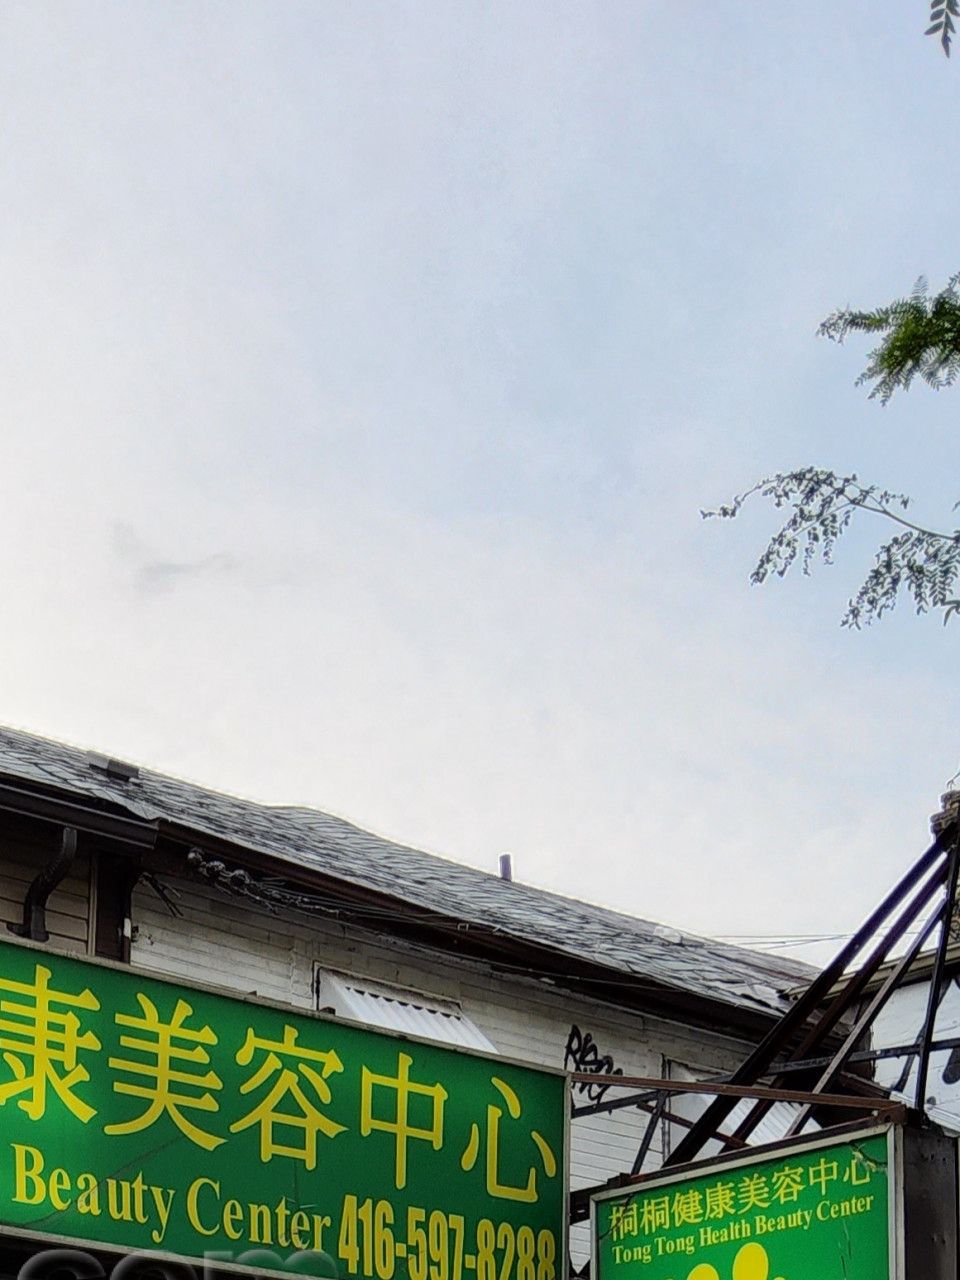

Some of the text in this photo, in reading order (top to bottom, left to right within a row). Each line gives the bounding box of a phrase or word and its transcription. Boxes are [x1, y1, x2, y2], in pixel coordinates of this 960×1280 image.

[11, 1143, 177, 1243] Beauty
[186, 1177, 332, 1253] Center
[611, 1195, 875, 1265] Tong Tong Health Beauty Center
